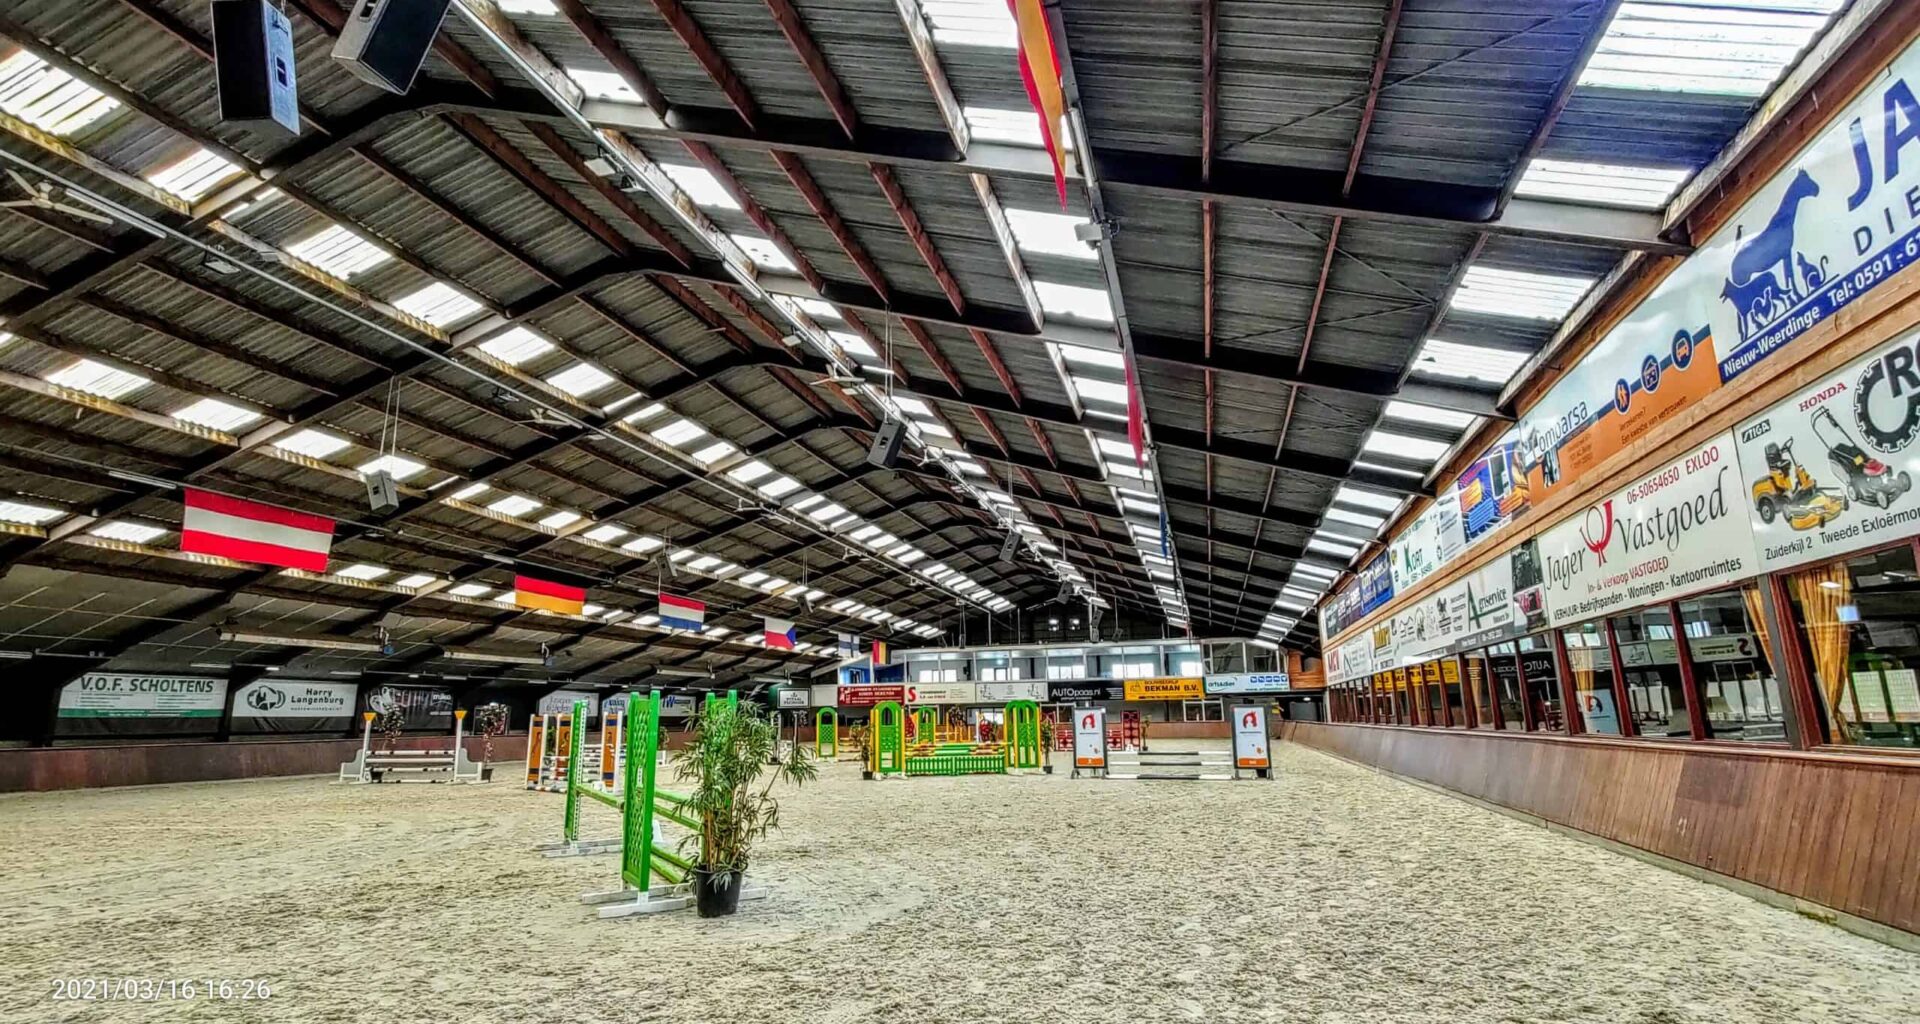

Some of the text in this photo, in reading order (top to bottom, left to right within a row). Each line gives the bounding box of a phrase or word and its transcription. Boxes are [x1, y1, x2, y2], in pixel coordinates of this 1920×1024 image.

[1724, 306, 1820, 377] Nieuw-Weerdinge
[1827, 281, 1854, 306] Tel:
[1855, 254, 1892, 289] 0591
[1798, 382, 1847, 412] HONDA
[1742, 419, 1770, 443] STIGA
[1626, 446, 1719, 505] 06-50654650 EXLOO
[1546, 466, 1728, 591] Jager Vastgoed
[1806, 537, 1813, 549] 2
[1819, 525, 1859, 545] Tweede
[1629, 556, 1668, 579] VASTGOED
[1553, 604, 1580, 620] VERHUUR:
[1579, 592, 1623, 614] Bedrijfspanden
[1628, 580, 1665, 598] Woningen
[1670, 557, 1742, 587] Kantoorruimtes
[80, 677, 214, 693] V.O.F. SCHOLTENS
[305, 688, 333, 697] Harry
[291, 696, 344, 705] Langenburg
